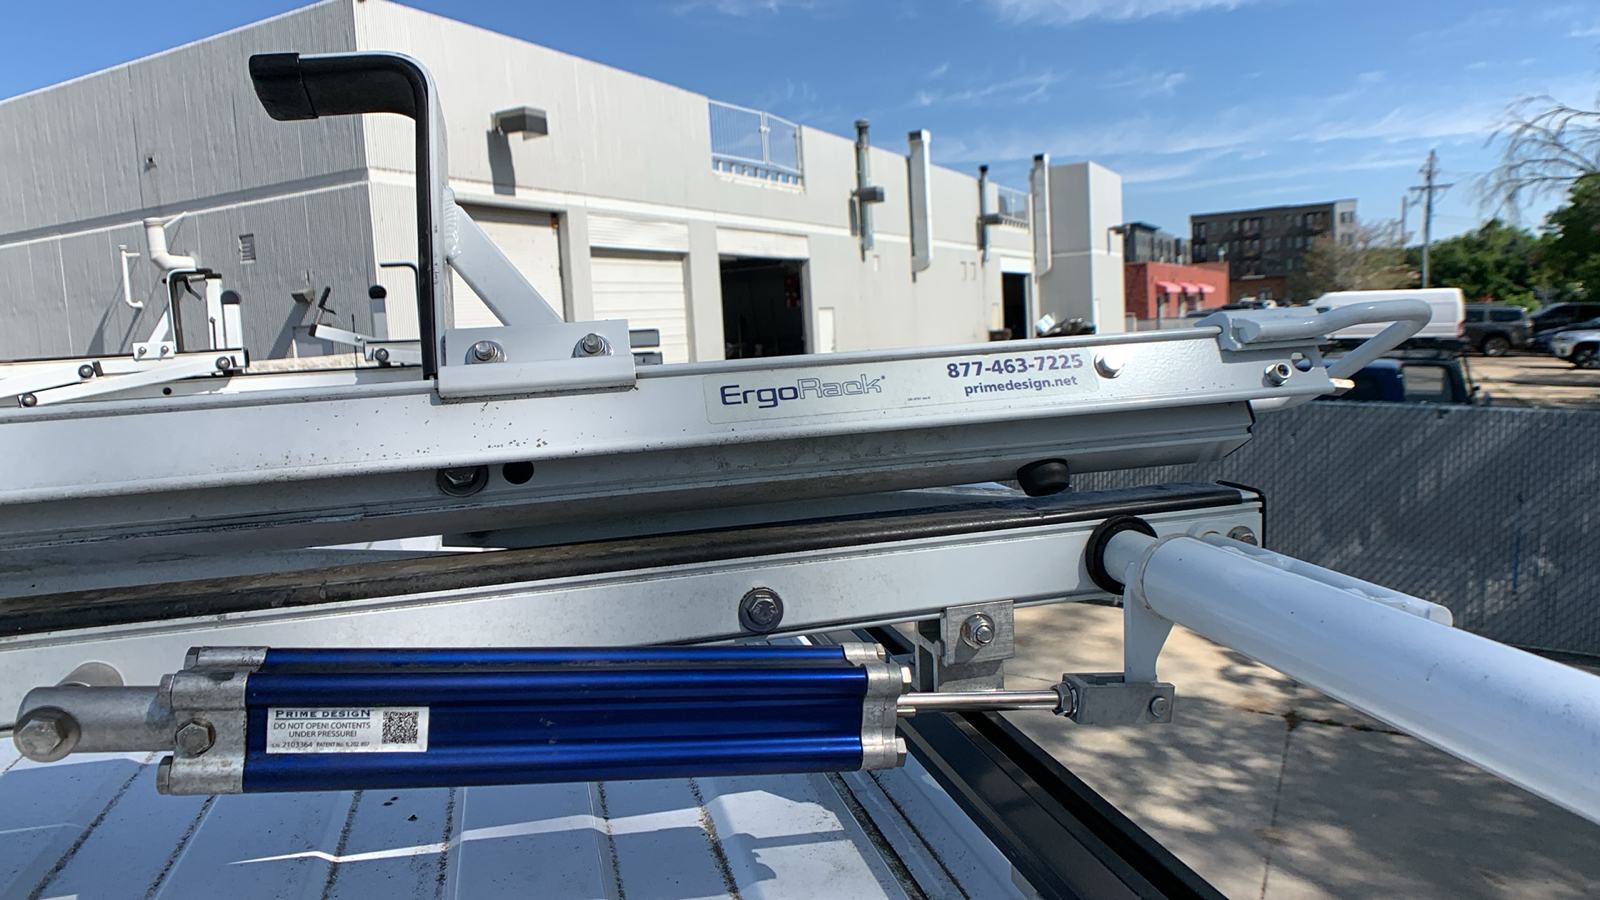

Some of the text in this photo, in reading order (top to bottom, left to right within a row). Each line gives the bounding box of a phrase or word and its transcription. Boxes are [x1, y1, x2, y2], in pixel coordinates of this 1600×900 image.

[946, 353, 1083, 378] 877-463-7225
[719, 374, 882, 408] ErgoRack
[964, 376, 1078, 396] primedesign.net
[273, 721, 371, 730] DO NOT OPEN! CONTENTS
[289, 730, 357, 738] UNDER PRESSURE!
